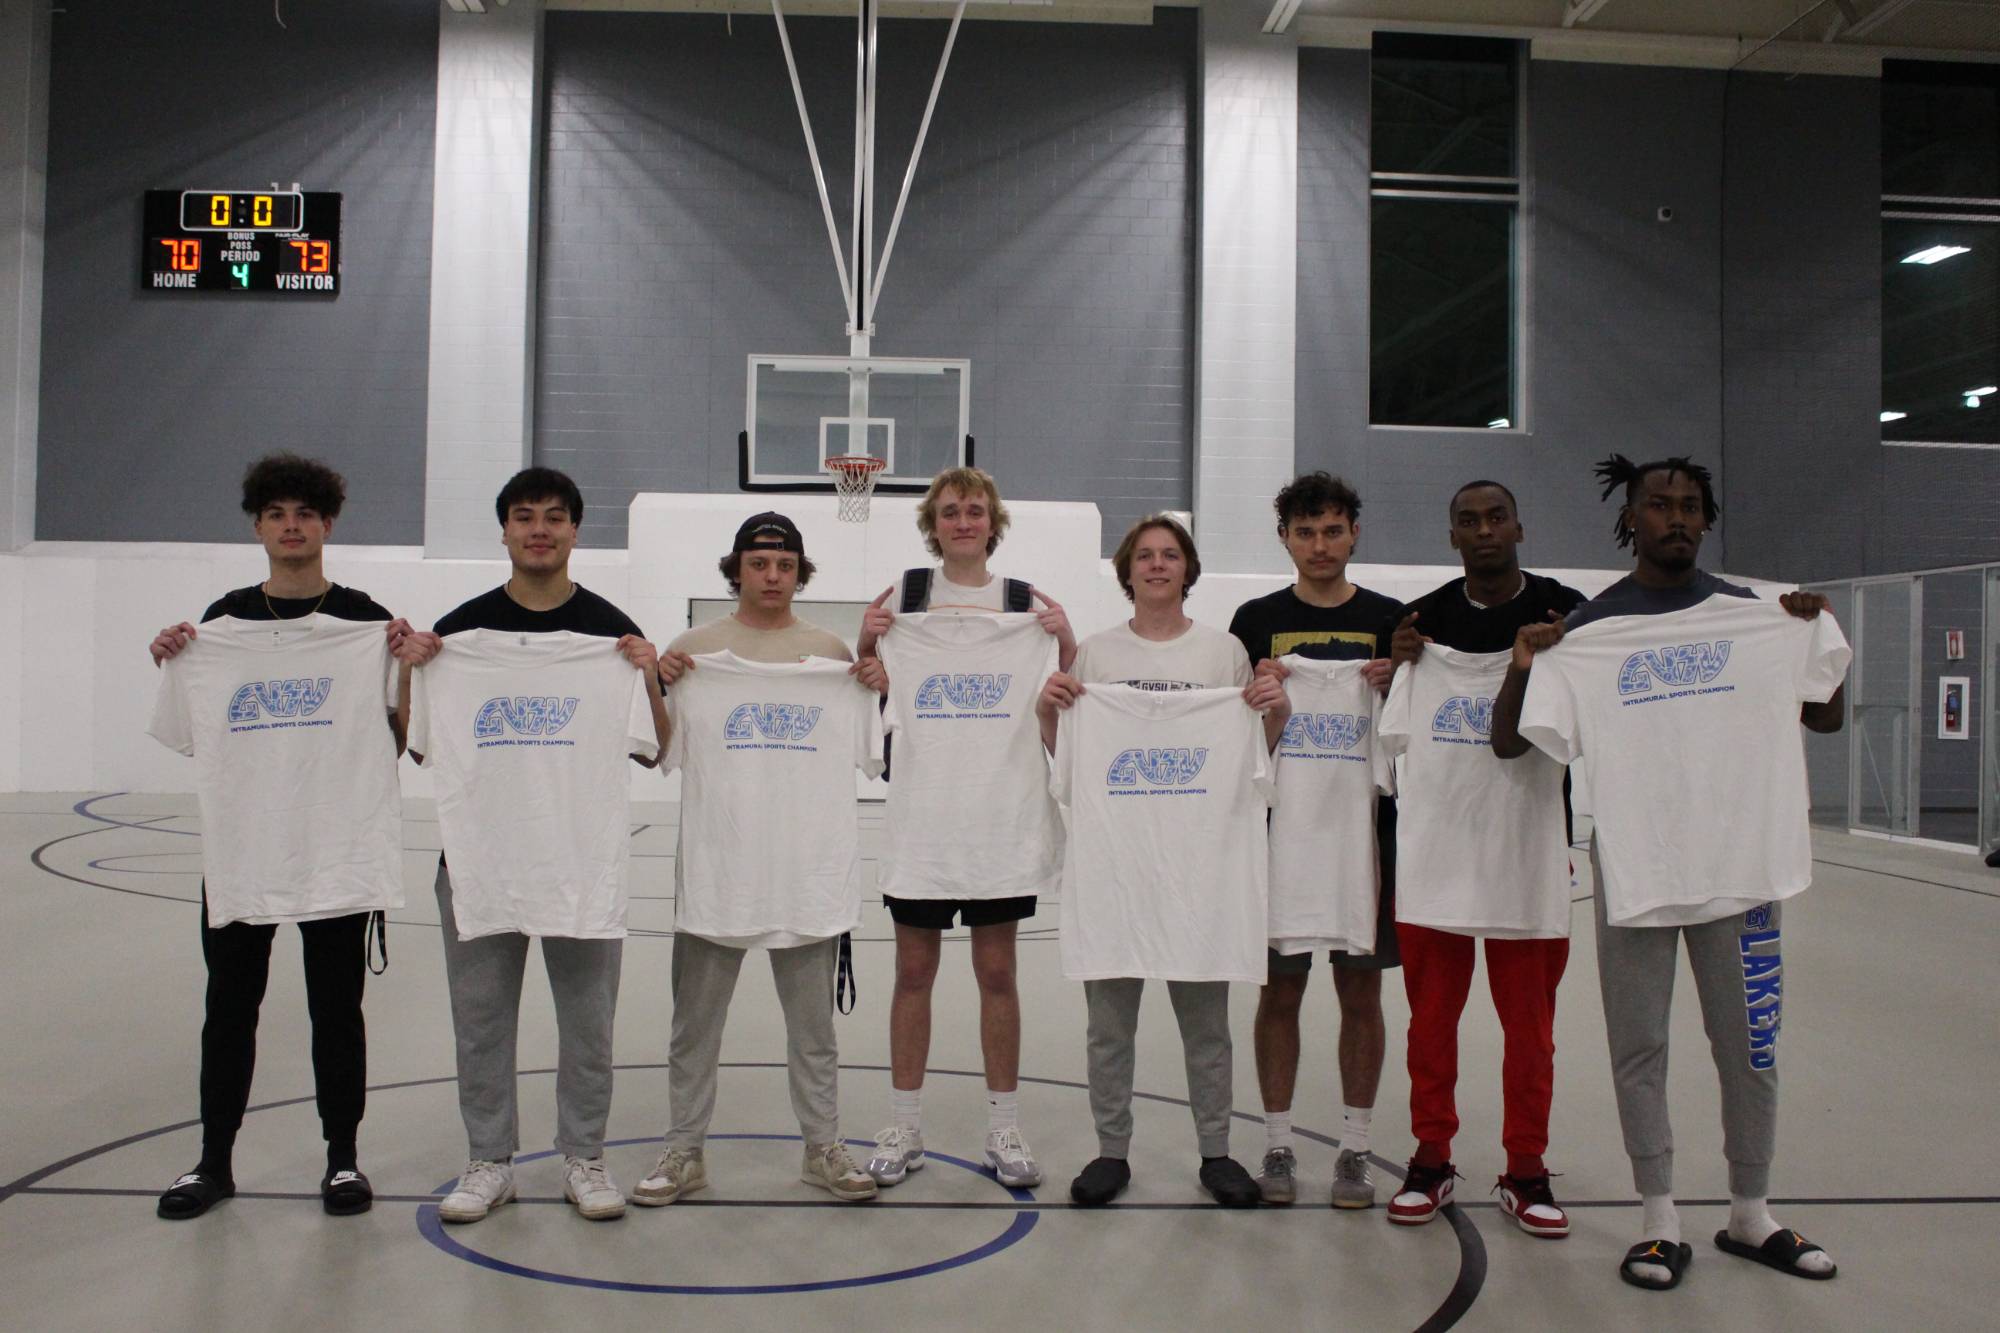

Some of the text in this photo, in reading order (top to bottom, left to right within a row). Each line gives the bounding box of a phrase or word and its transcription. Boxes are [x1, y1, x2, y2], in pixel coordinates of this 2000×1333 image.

[227, 232, 255, 241] BONUS
[230, 241, 252, 250] POSS
[160, 239, 200, 271] 70
[220, 250, 260, 262] PERIOD
[289, 240, 328, 272] 73
[153, 272, 197, 289] HOME
[231, 262, 249, 288] 4
[275, 274, 334, 290] VISITOR
[1141, 682, 1168, 692] GVSU
[1622, 685, 1735, 706] INTRAMURAL SPORTS CHAMPION
[1432, 736, 1472, 744] INTRAMURAL
